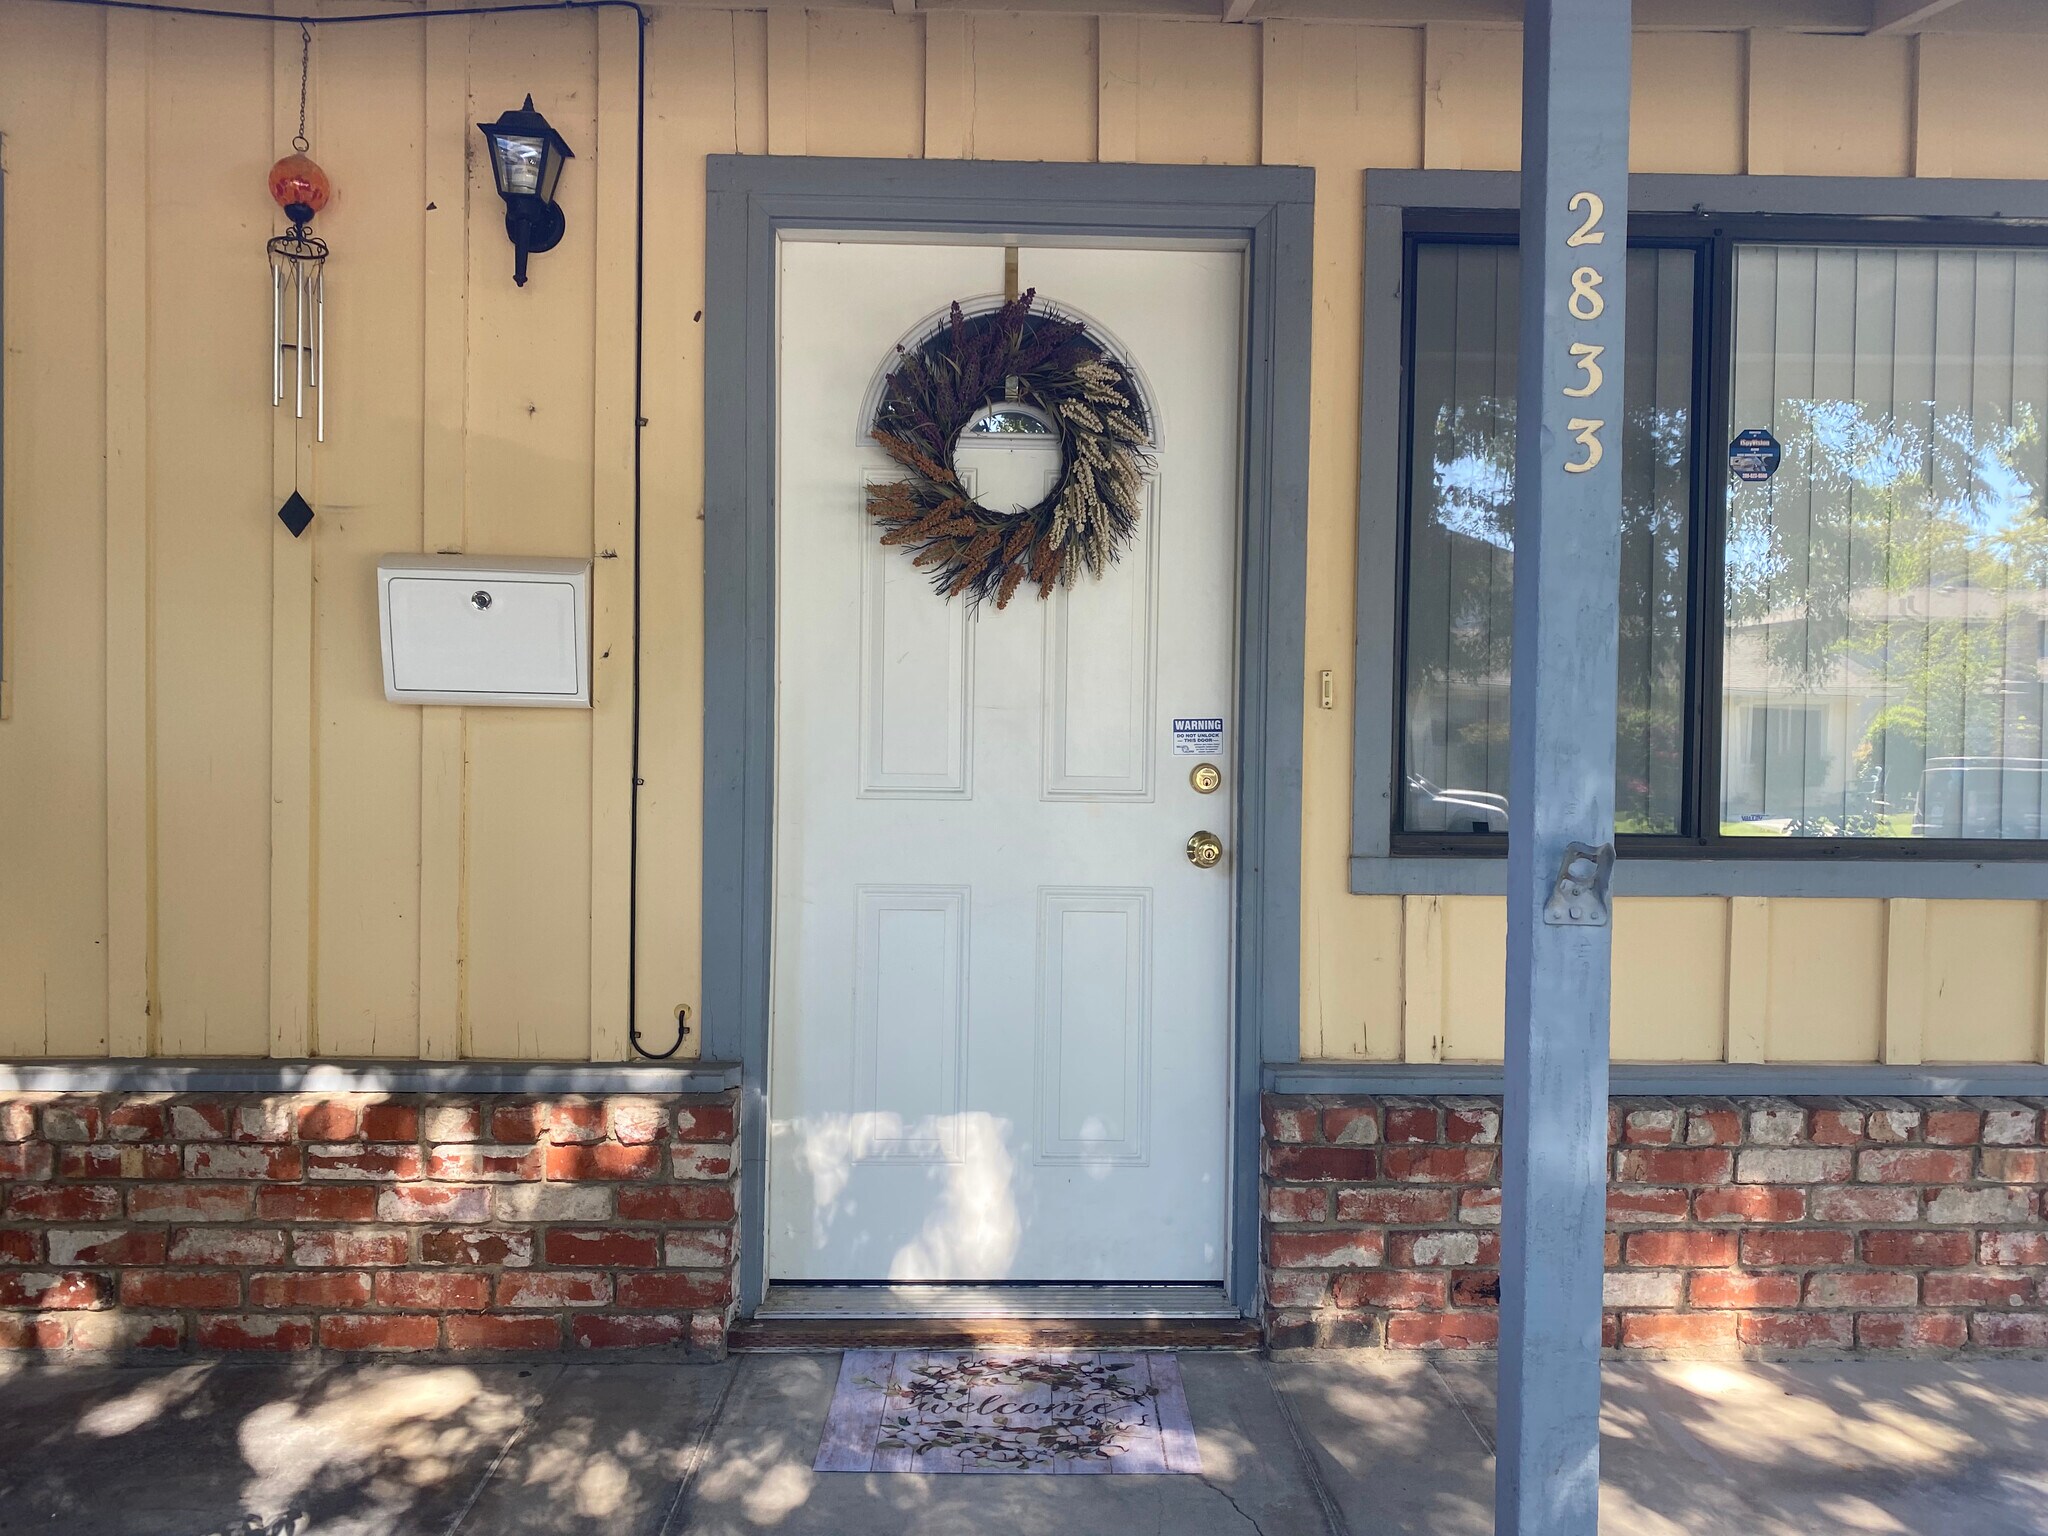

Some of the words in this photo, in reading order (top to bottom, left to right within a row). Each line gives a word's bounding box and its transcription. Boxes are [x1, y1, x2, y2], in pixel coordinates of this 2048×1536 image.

[1563, 191, 1604, 473] 2833
[1175, 720, 1221, 730] WARNING
[905, 1394, 1131, 1416] welcome
